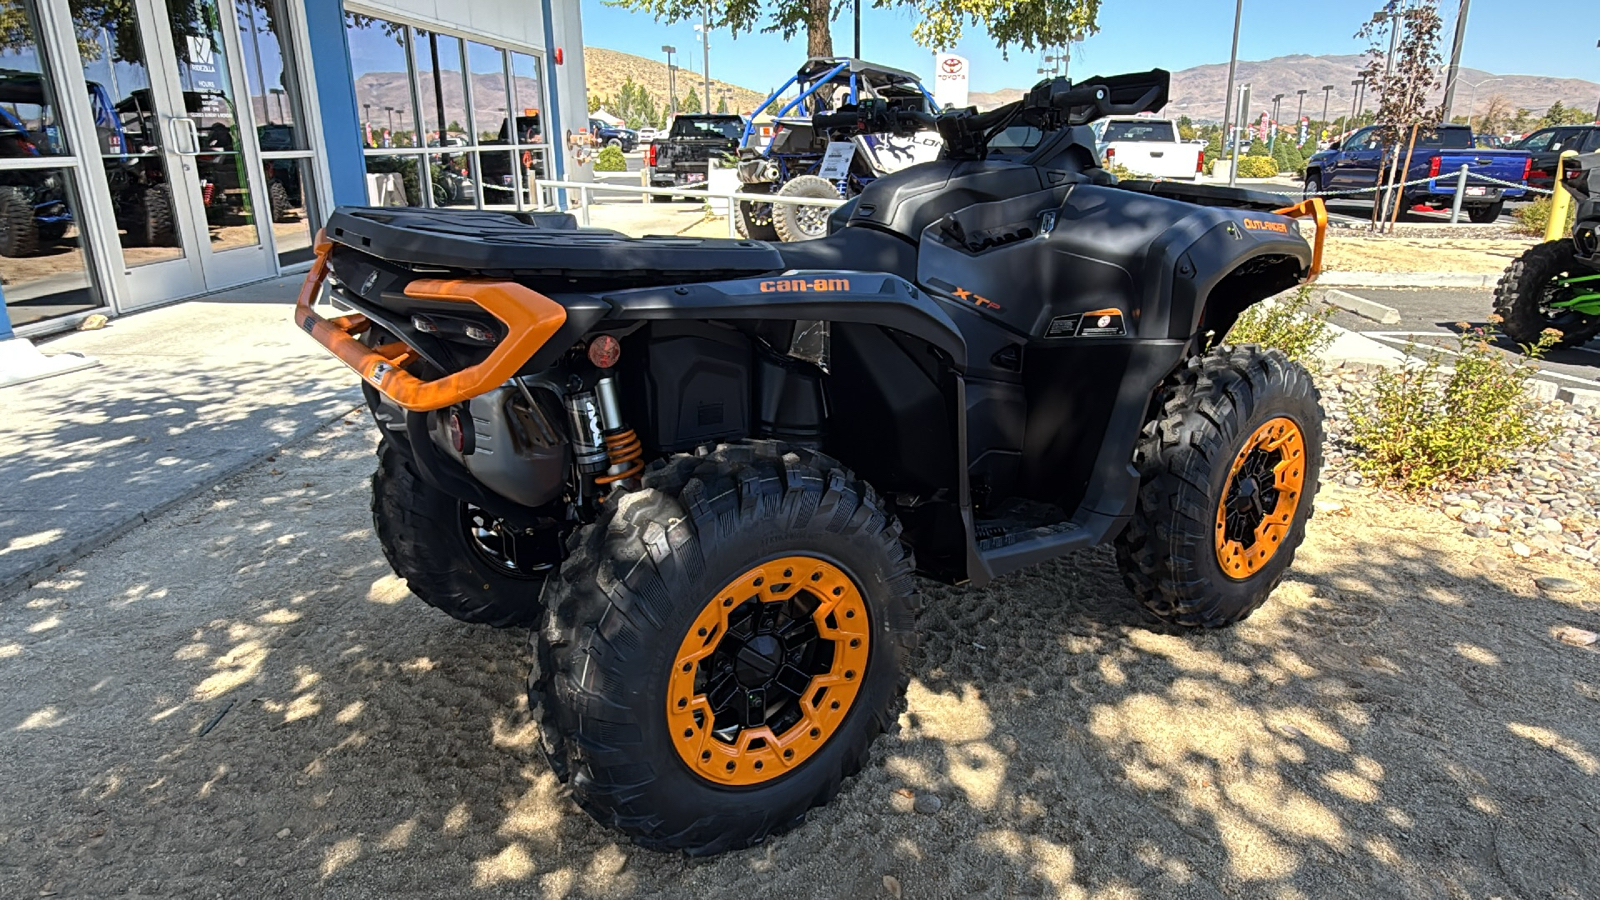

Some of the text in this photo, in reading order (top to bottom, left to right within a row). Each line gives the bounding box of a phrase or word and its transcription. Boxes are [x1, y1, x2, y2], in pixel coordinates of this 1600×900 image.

[1243, 217, 1288, 234] OUTLANDER
[760, 278, 850, 293] can-am
[951, 286, 1001, 309] XTP
